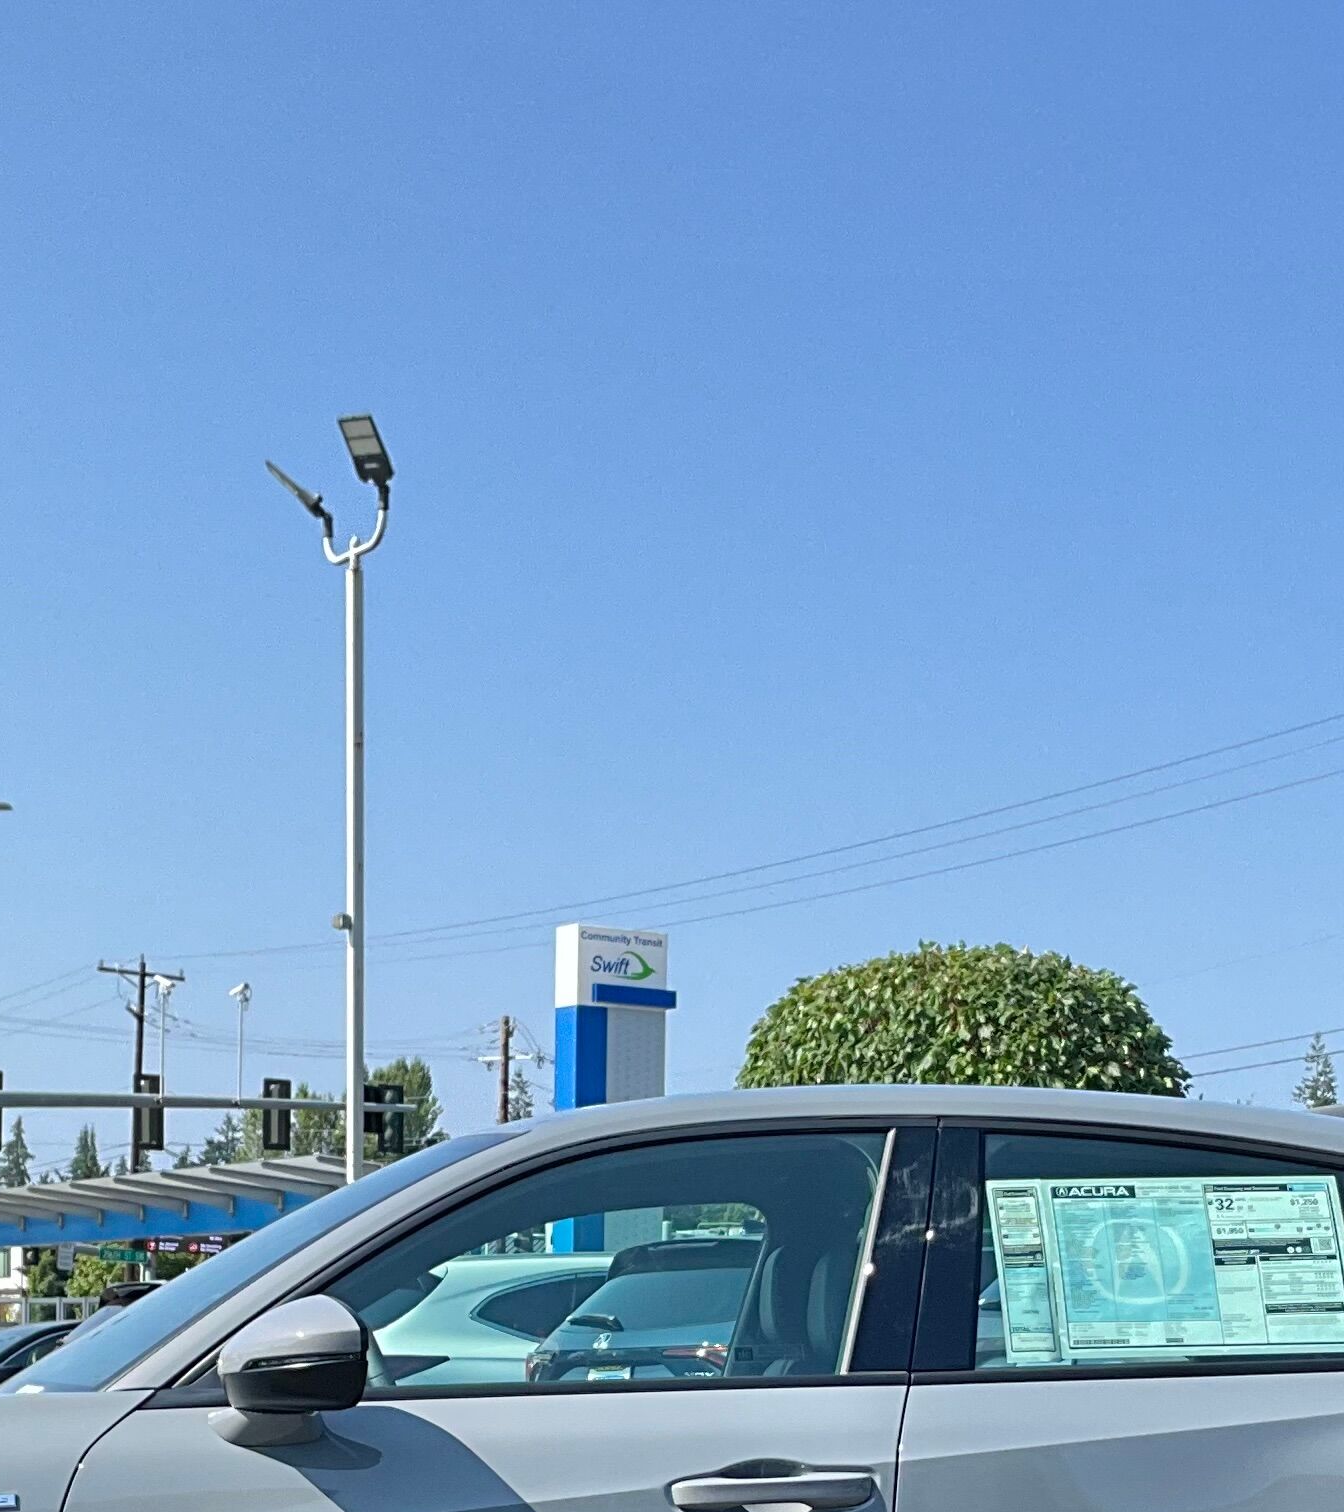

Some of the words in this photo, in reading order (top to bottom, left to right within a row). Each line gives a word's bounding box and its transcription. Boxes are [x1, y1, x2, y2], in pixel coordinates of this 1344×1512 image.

[580, 930, 632, 947] Community
[633, 935, 663, 948] Transit
[590, 955, 631, 976] Swift
[1068, 1186, 1130, 1197] ACURA
[1214, 1198, 1235, 1211] 32
